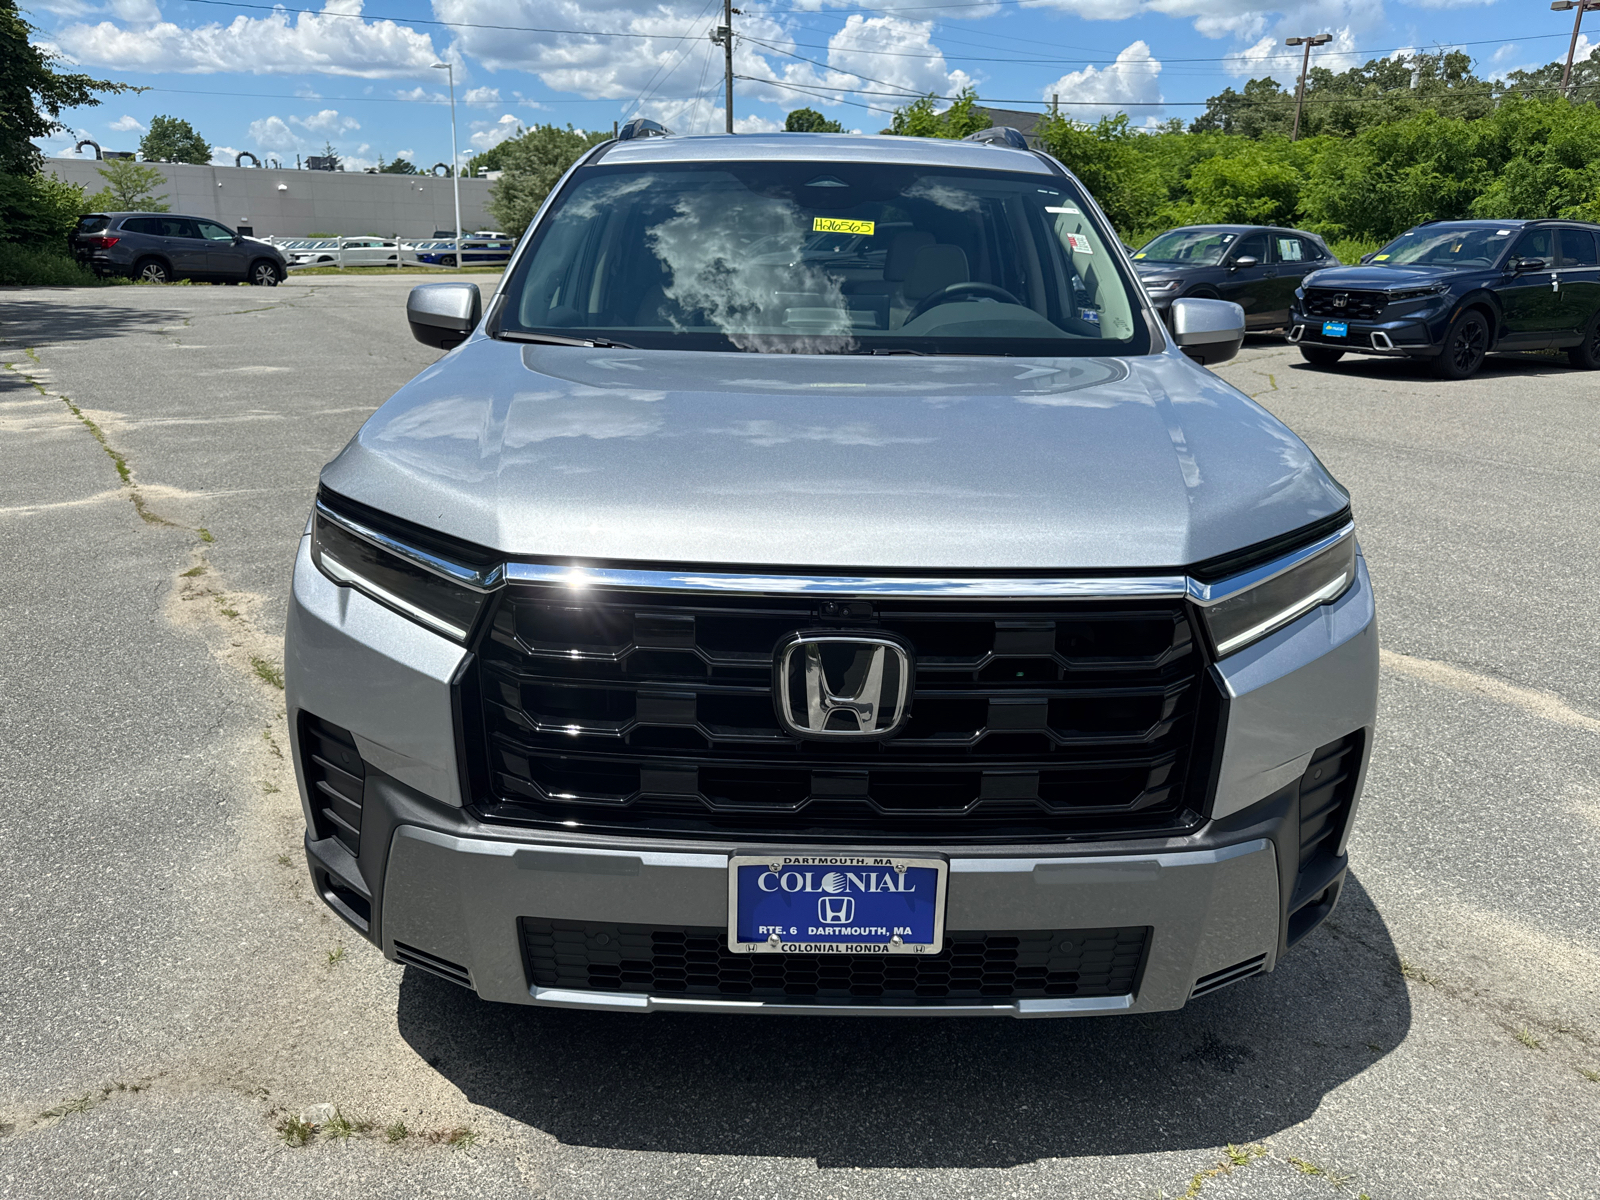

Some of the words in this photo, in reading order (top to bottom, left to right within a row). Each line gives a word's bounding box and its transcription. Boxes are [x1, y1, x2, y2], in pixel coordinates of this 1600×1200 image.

[814, 218, 873, 233] H26565
[873, 858, 893, 866] MA
[757, 871, 916, 894] COLONIAL
[758, 925, 786, 935] RTE.
[789, 926, 798, 935] 6
[808, 926, 890, 937] DARTMOUTH,
[893, 926, 913, 936] MA
[781, 943, 842, 953] COLONIAL
[845, 944, 889, 953] HONDA
